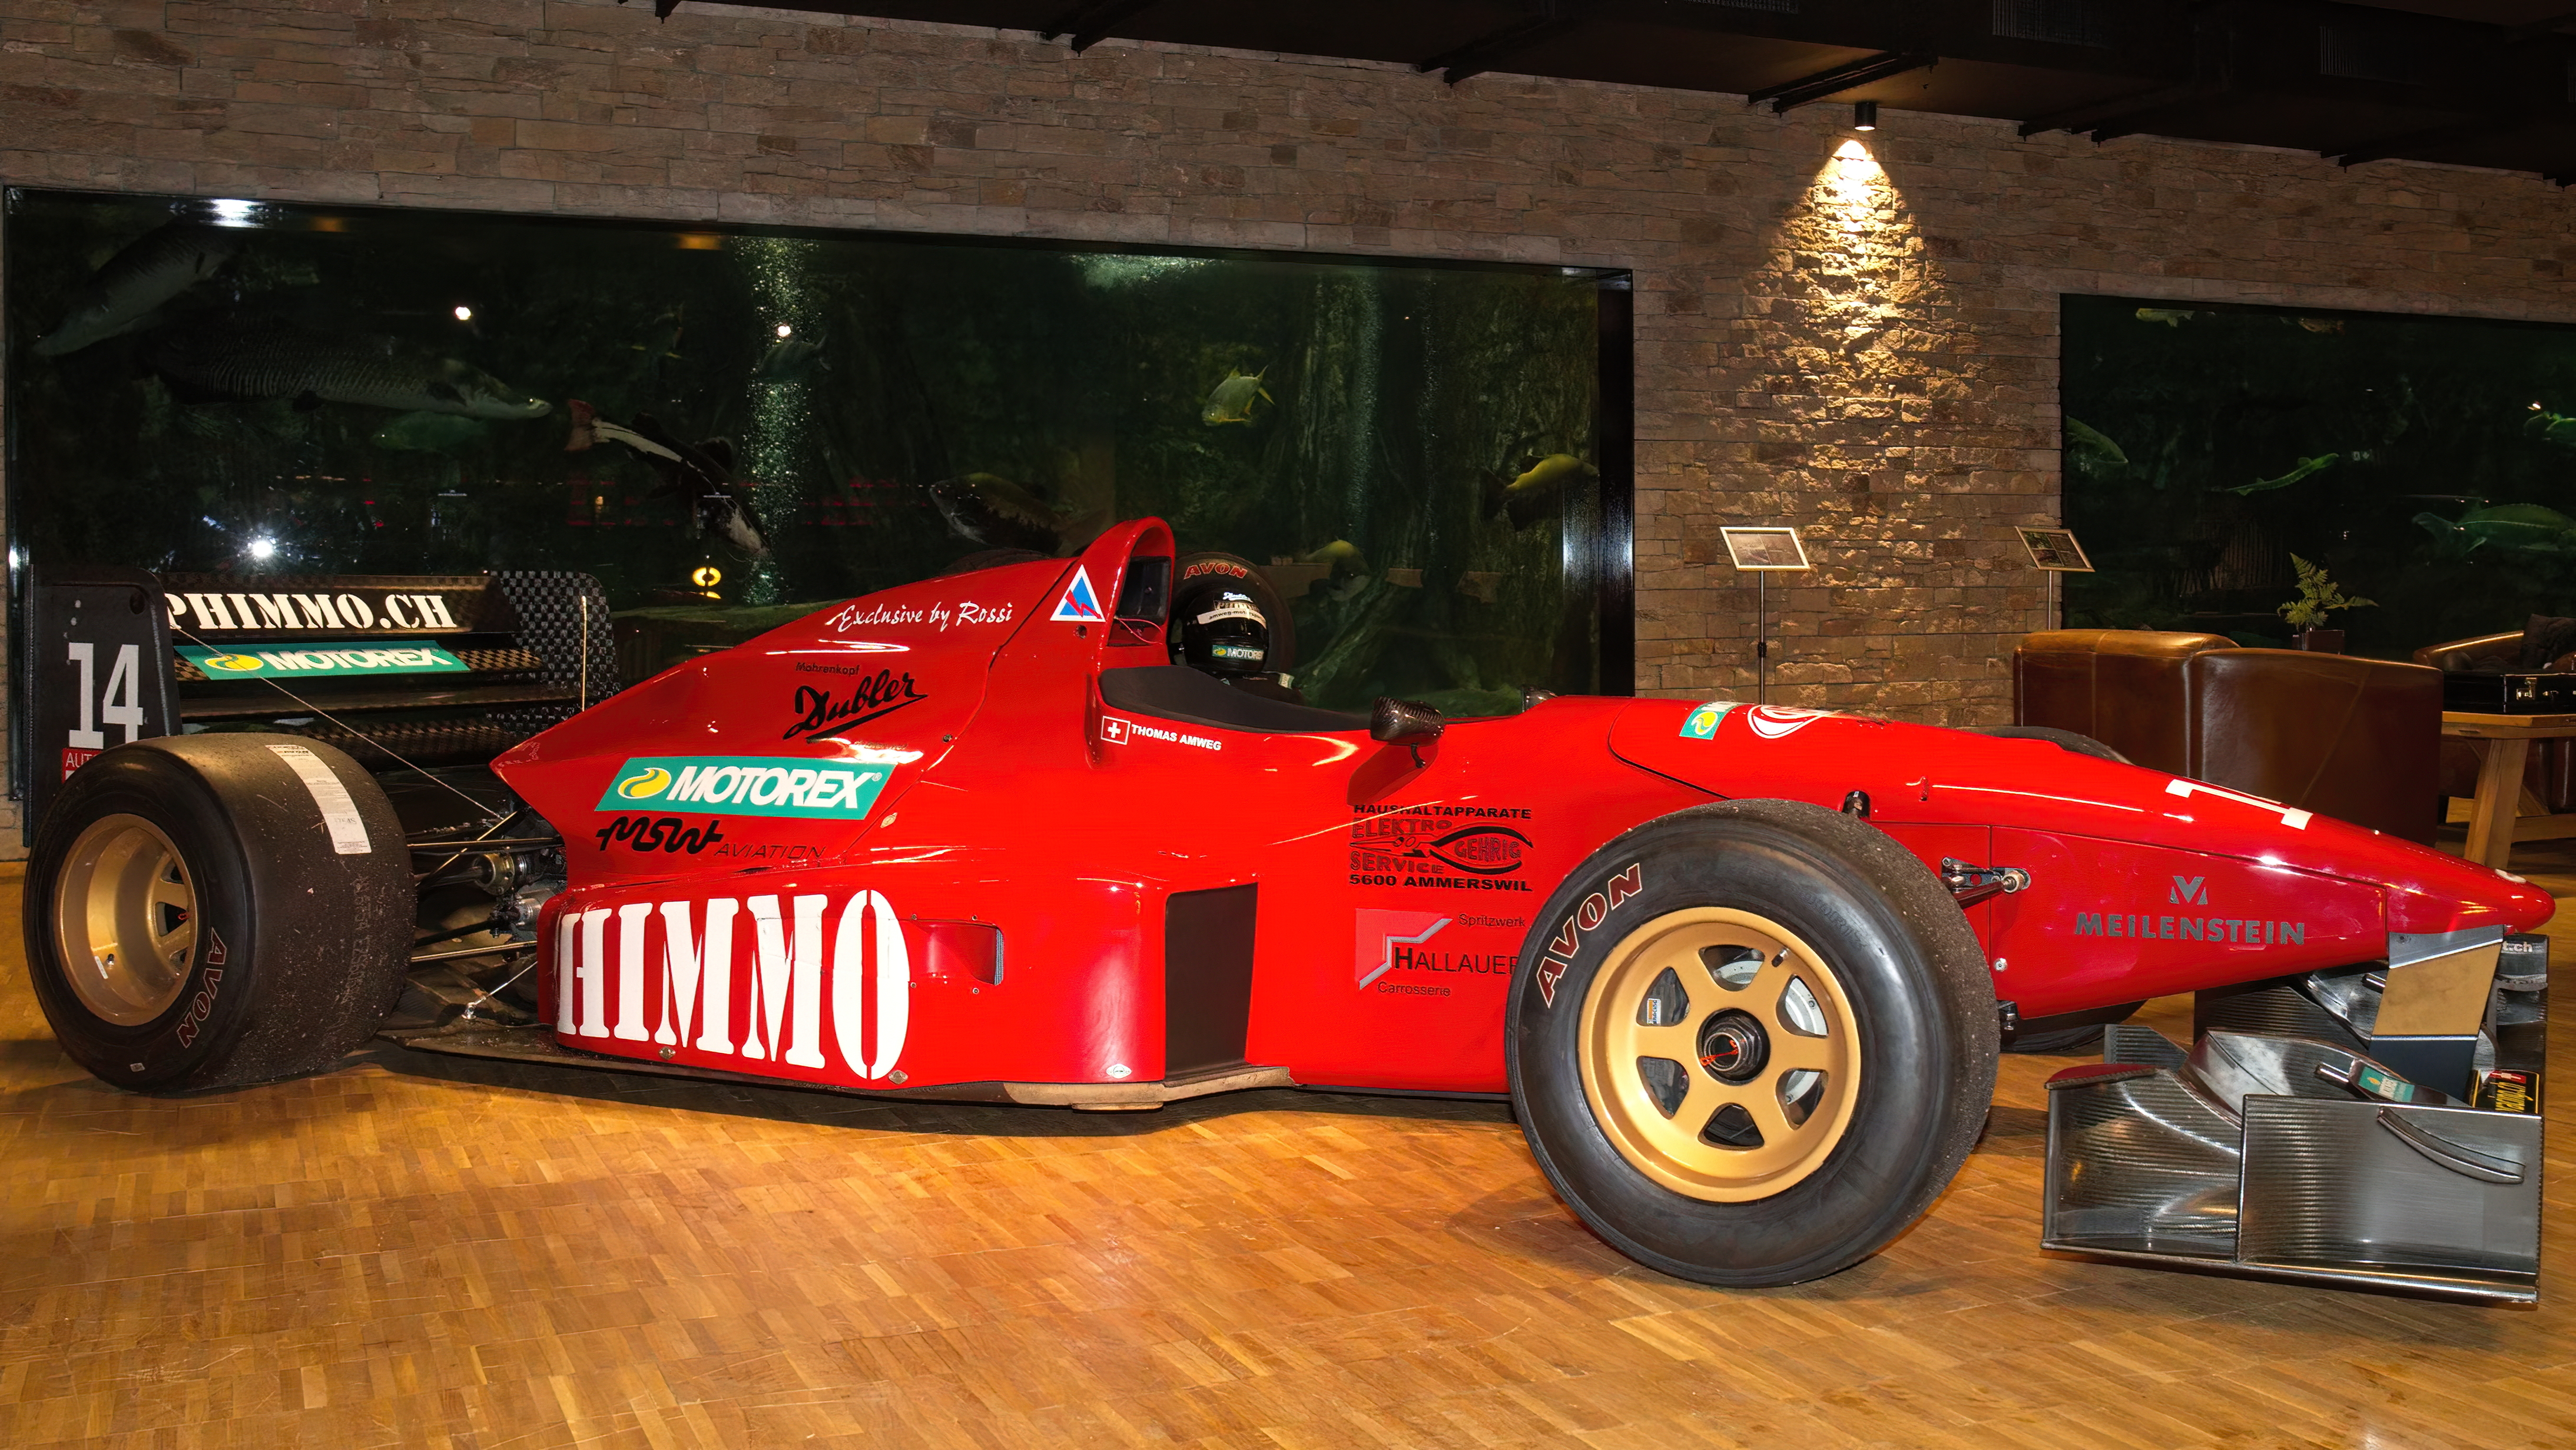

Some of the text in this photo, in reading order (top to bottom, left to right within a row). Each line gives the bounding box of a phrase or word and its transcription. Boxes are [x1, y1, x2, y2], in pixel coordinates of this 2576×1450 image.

[1183, 562, 1248, 580] AVON
[164, 592, 457, 630] PHIMMO.CH
[825, 600, 1013, 632] Exclusive by Rossi
[69, 642, 143, 749] 14
[1131, 724, 1222, 751] THOMAS AMWEG
[65, 753, 98, 768] AUT
[1354, 805, 1532, 819] HAUSHALTAPPARATE
[1351, 817, 1452, 839] ELEKTRO
[714, 843, 826, 860] AVIATION
[1350, 850, 1444, 874] SERVICE
[1454, 837, 1521, 862] GEHRIG
[1349, 874, 1533, 892] 5600 AMMERSWIL
[1536, 863, 1643, 1009] AVON
[2074, 912, 2305, 945] MEILENSTEIN
[177, 926, 227, 1048] AVON
[557, 889, 910, 1080] HIMMO
